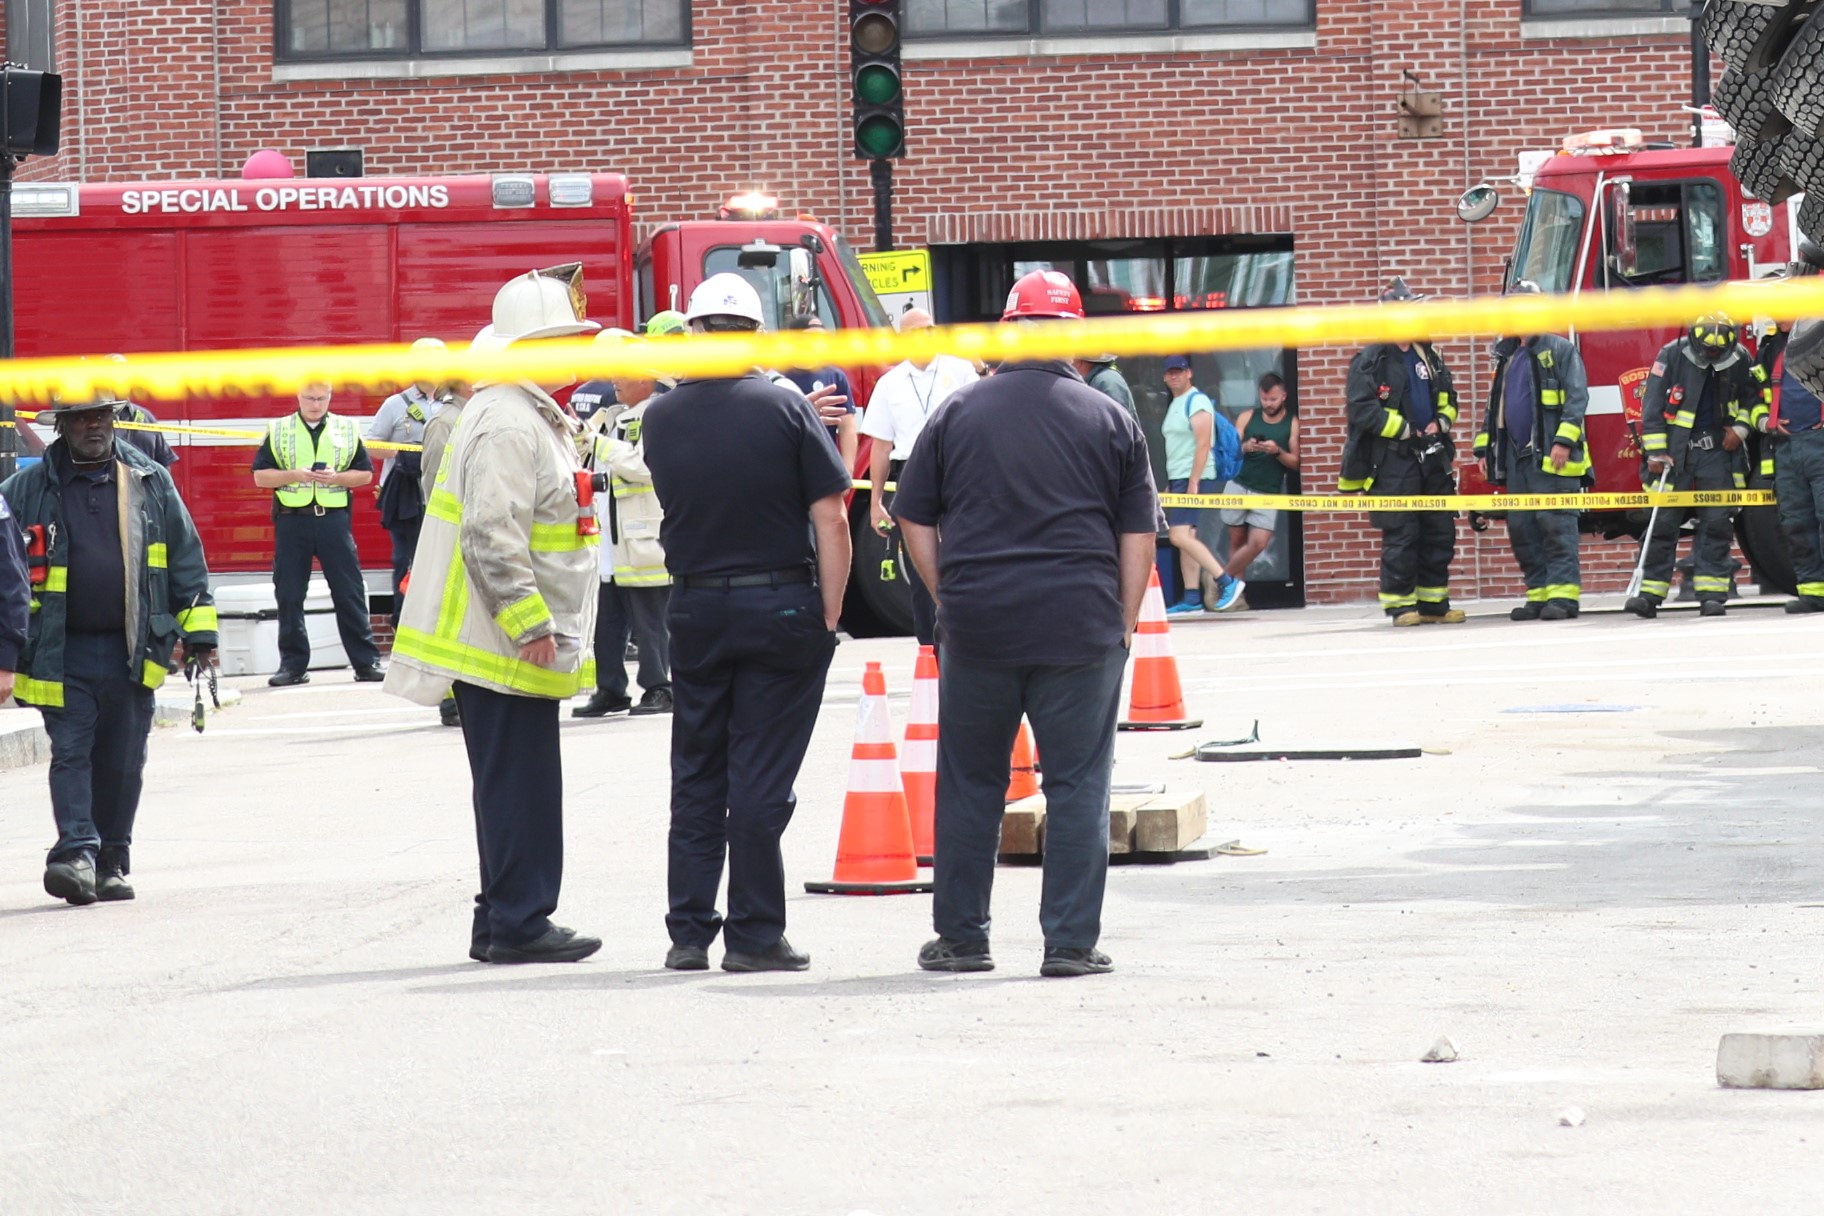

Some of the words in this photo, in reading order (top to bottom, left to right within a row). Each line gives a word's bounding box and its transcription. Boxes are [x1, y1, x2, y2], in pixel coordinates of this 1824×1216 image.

[121, 188, 248, 214] SPECIAL
[256, 185, 449, 210] OPERATIONS
[869, 277, 899, 289] CLES
[1046, 288, 1071, 298] SAFETY
[1050, 296, 1070, 305] FIRST
[1177, 496, 1205, 505] POLICE
[1208, 497, 1244, 506] BOSTON
[1491, 497, 1520, 507] CROSS
[1523, 497, 1541, 507] NOT
[1544, 497, 1557, 506] DO
[1560, 496, 1578, 506] LINE
[1581, 496, 1610, 506] POLICE
[1614, 495, 1649, 505] BOSTON
[1693, 493, 1722, 503] CROSS
[1726, 493, 1743, 503] NOT
[1746, 493, 1758, 502] DO
[1289, 498, 1318, 508] CROSS
[1322, 498, 1338, 508] NOT
[1342, 498, 1354, 508] DO
[1357, 498, 1377, 508] LINE
[1378, 498, 1408, 508] POLICE
[1411, 498, 1447, 508] BOSTON
